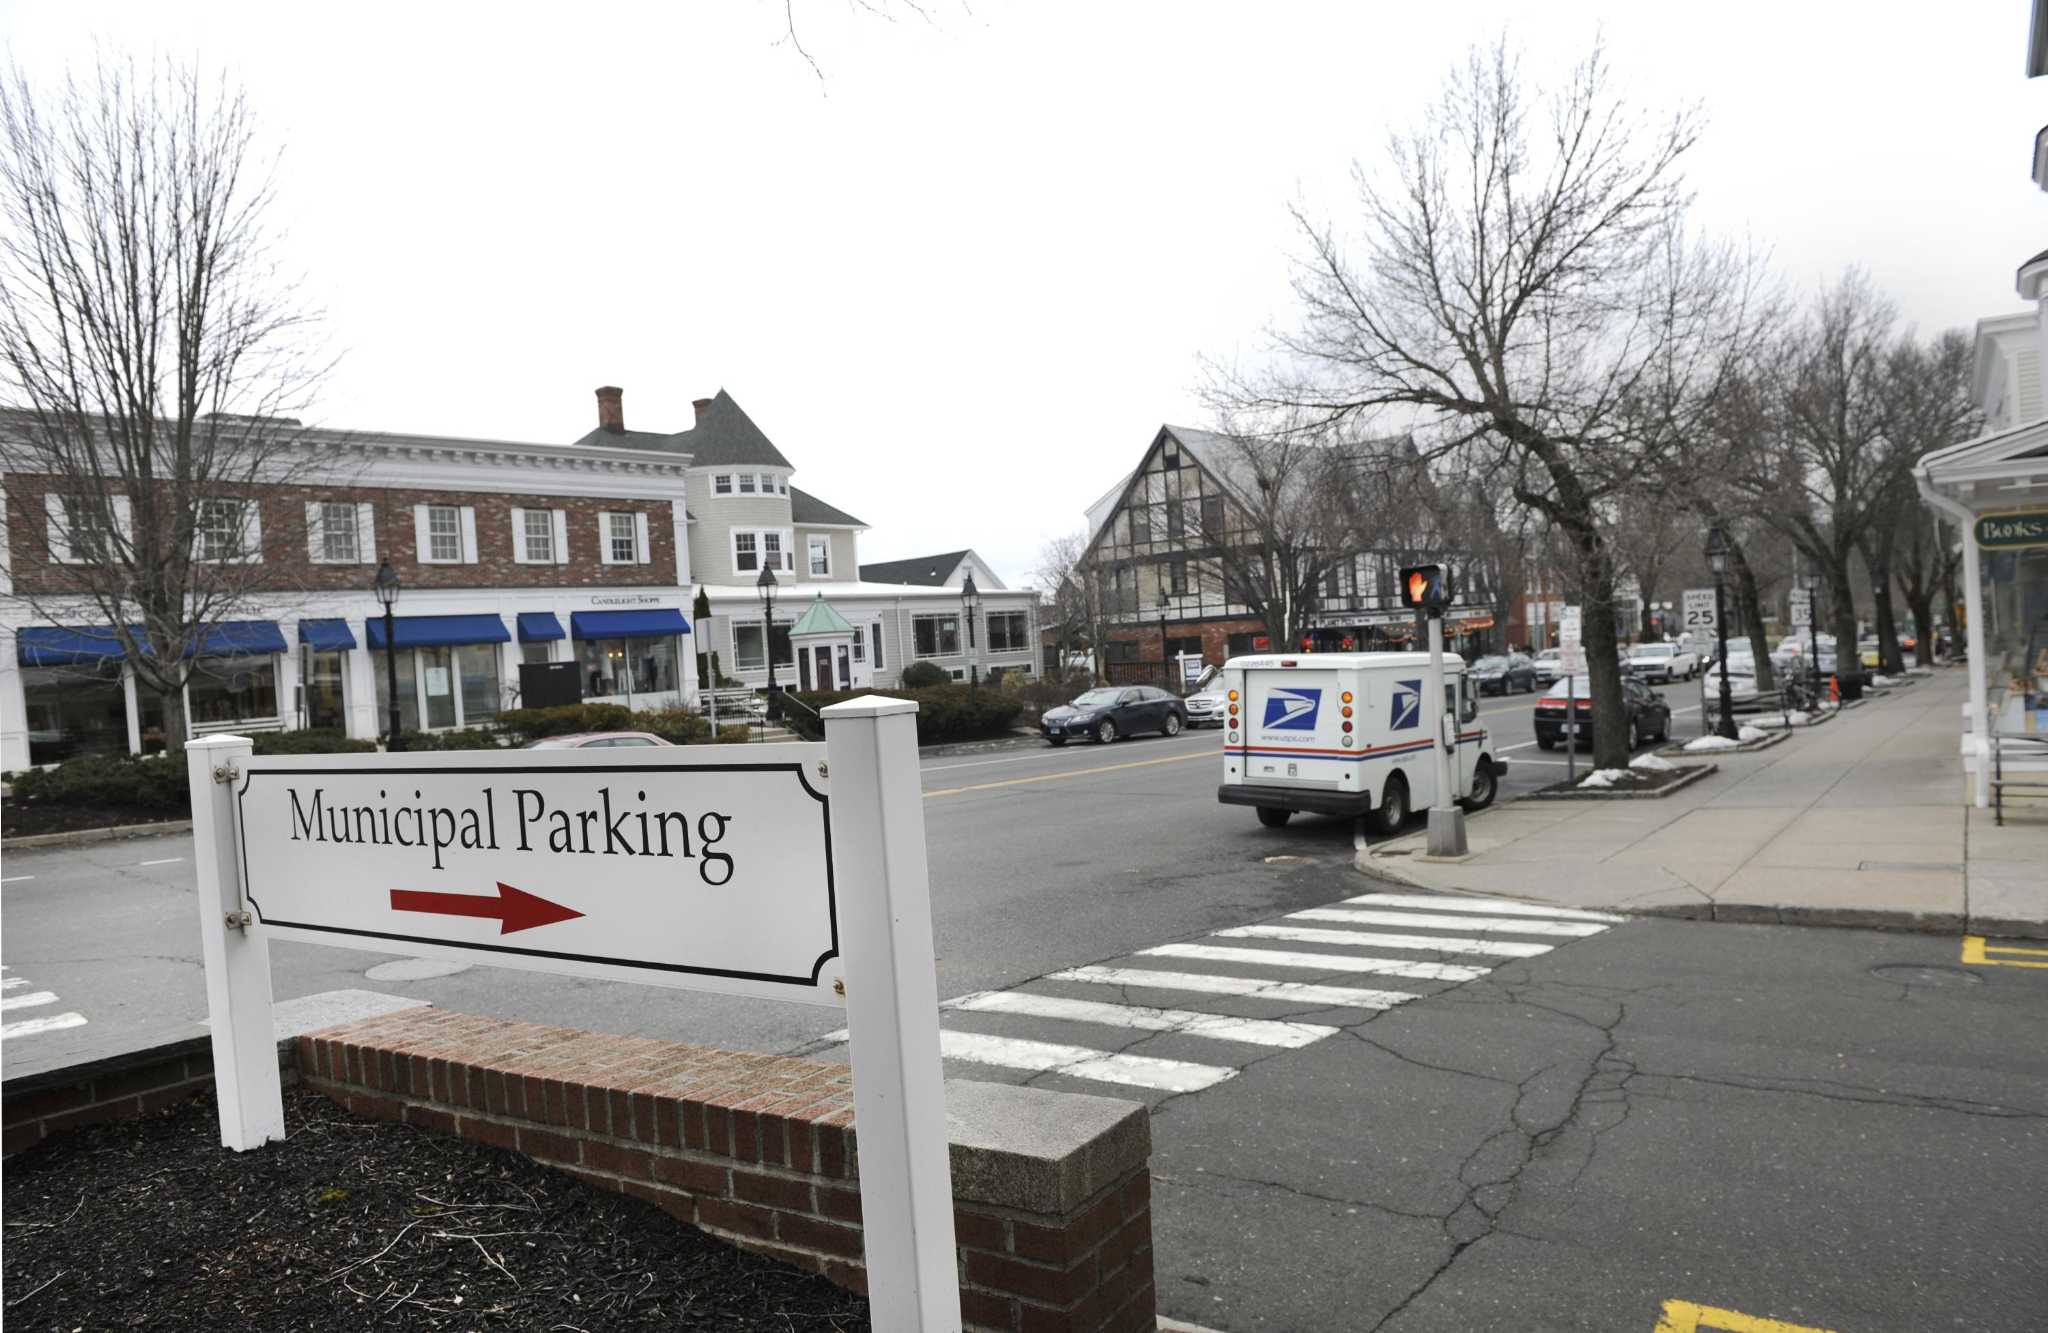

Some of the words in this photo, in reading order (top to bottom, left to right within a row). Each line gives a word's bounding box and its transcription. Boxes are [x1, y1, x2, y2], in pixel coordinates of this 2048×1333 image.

[1687, 610, 1714, 626] 25
[1261, 734, 1316, 743] www.usps.com
[287, 787, 500, 870] Municipal
[512, 787, 735, 886] Parking
